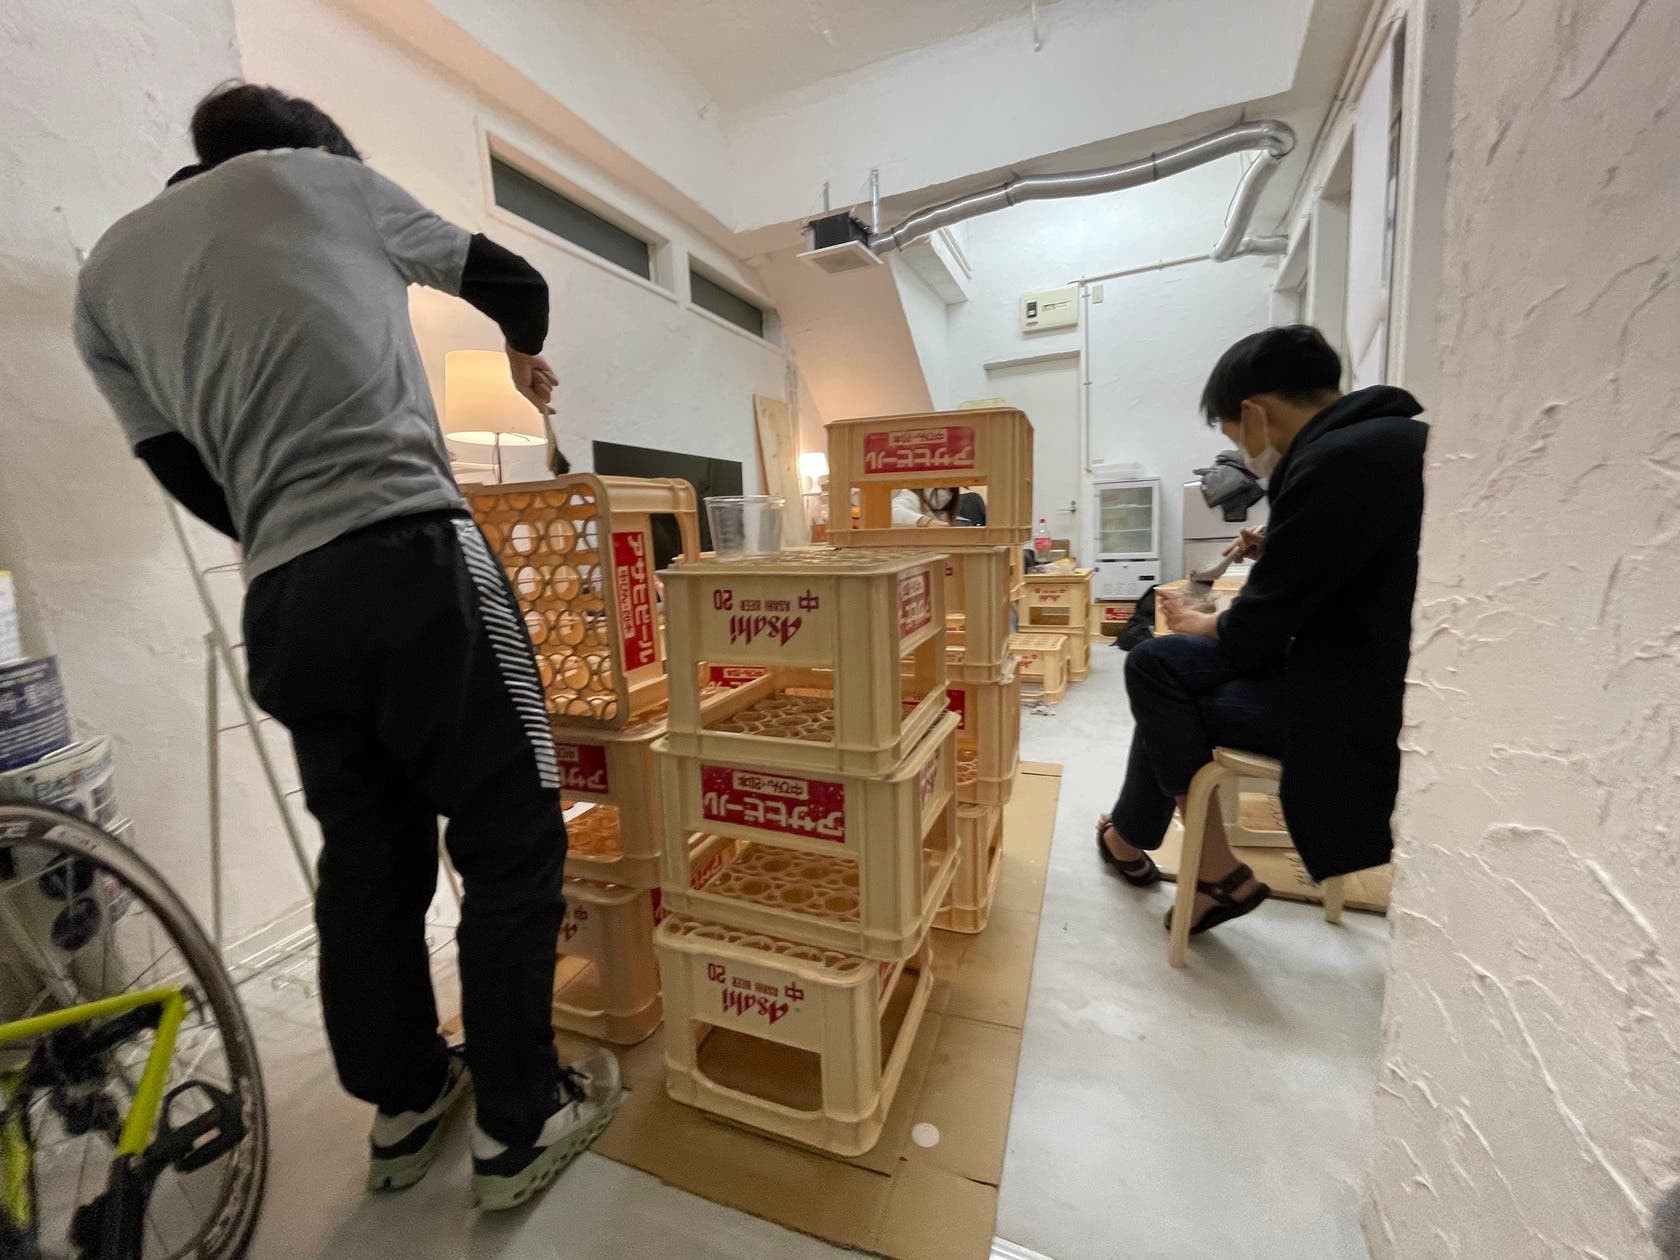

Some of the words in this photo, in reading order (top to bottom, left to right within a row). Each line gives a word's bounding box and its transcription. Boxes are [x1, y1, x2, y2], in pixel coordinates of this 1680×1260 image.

[864, 446, 974, 470] アサヒビール
[627, 534, 654, 663] アサヒビール
[713, 589, 733, 611] 20
[798, 589, 820, 612] 中
[729, 615, 802, 647] Asahi
[703, 791, 844, 837] アサヒビール
[707, 963, 726, 984] 20
[784, 981, 805, 1002] 中
[721, 988, 789, 1025] Asahi
